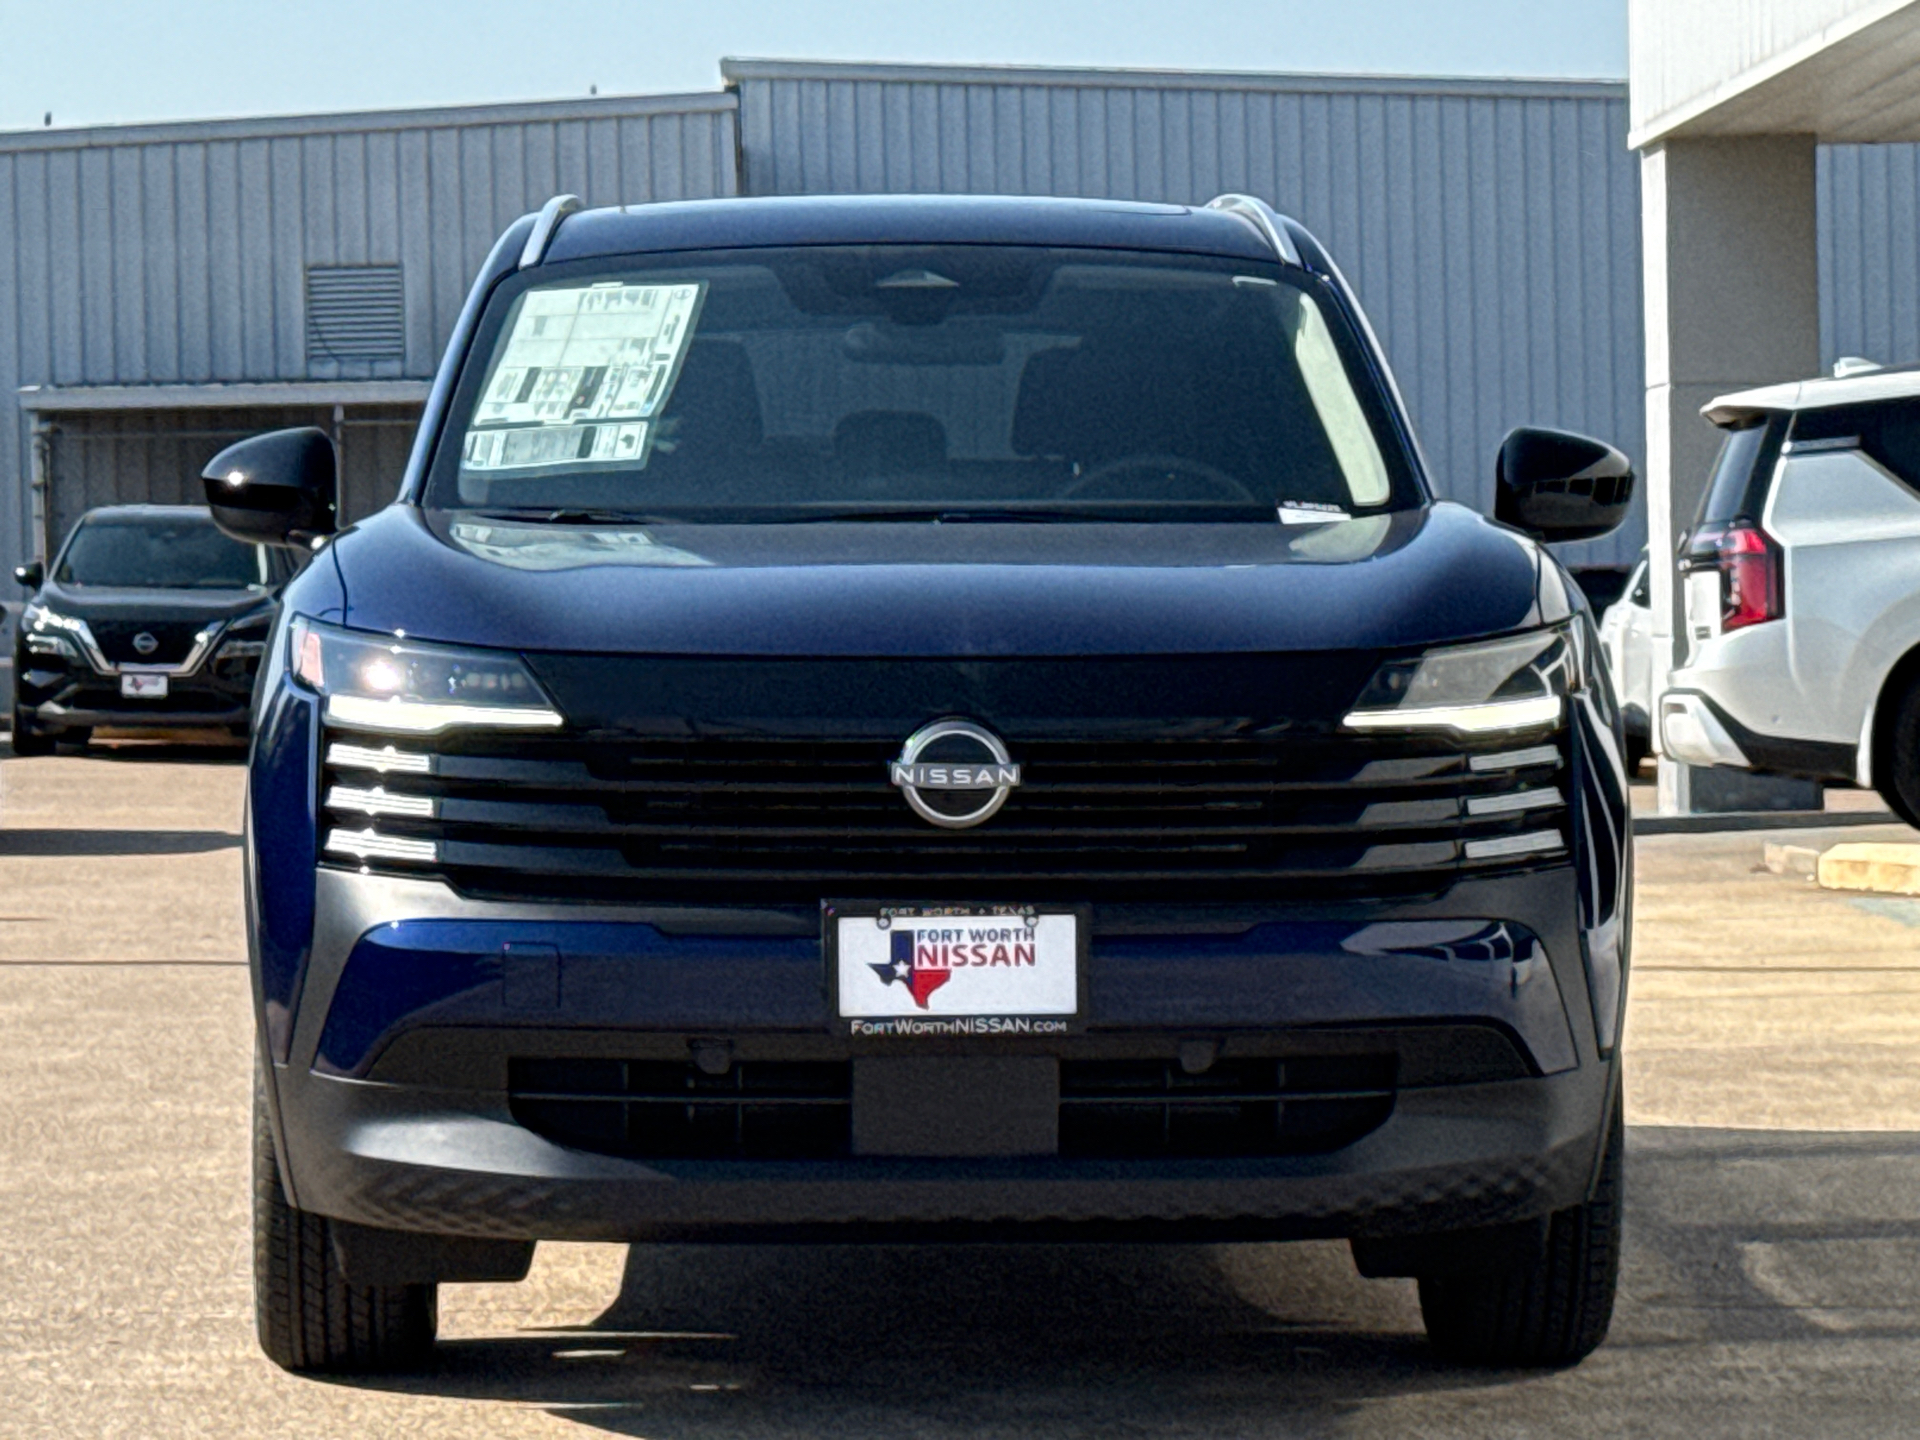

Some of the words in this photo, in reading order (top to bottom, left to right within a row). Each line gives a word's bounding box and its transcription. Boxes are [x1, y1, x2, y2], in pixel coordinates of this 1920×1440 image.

[895, 766, 1017, 785] NISSAN
[917, 929, 963, 943] FORT
[968, 928, 1035, 942] WORTH
[917, 943, 1036, 967] NISSAN
